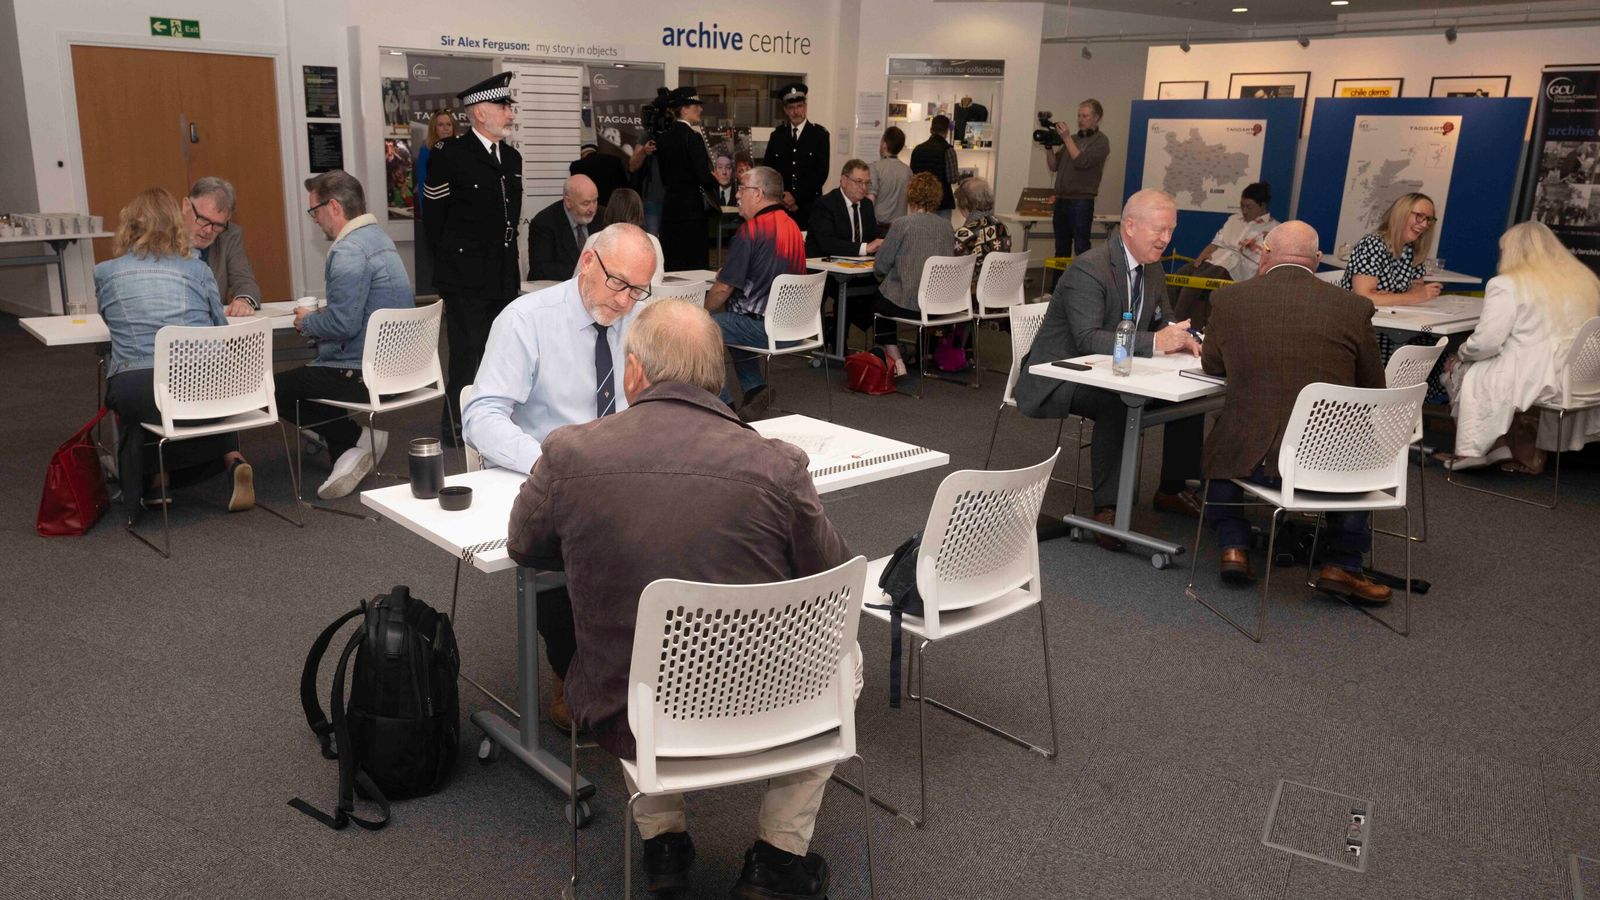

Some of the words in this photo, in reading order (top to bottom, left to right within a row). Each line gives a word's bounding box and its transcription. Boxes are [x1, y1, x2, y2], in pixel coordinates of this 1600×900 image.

[185, 25, 199, 33] Exit
[662, 21, 743, 51] archive
[749, 30, 811, 56] centre
[441, 35, 455, 46] Sir
[458, 37, 480, 48] Alex
[483, 38, 530, 51] Ferguson:
[536, 44, 550, 56] my
[552, 44, 575, 56] story
[577, 45, 585, 54] in
[587, 45, 618, 57] objects
[967, 65, 1001, 74] collections
[1350, 88, 1367, 97] chile
[1368, 88, 1390, 96] demo
[1550, 85, 1576, 95] GCU
[597, 115, 642, 125] TAGGAR
[1547, 125, 1595, 137] archive
